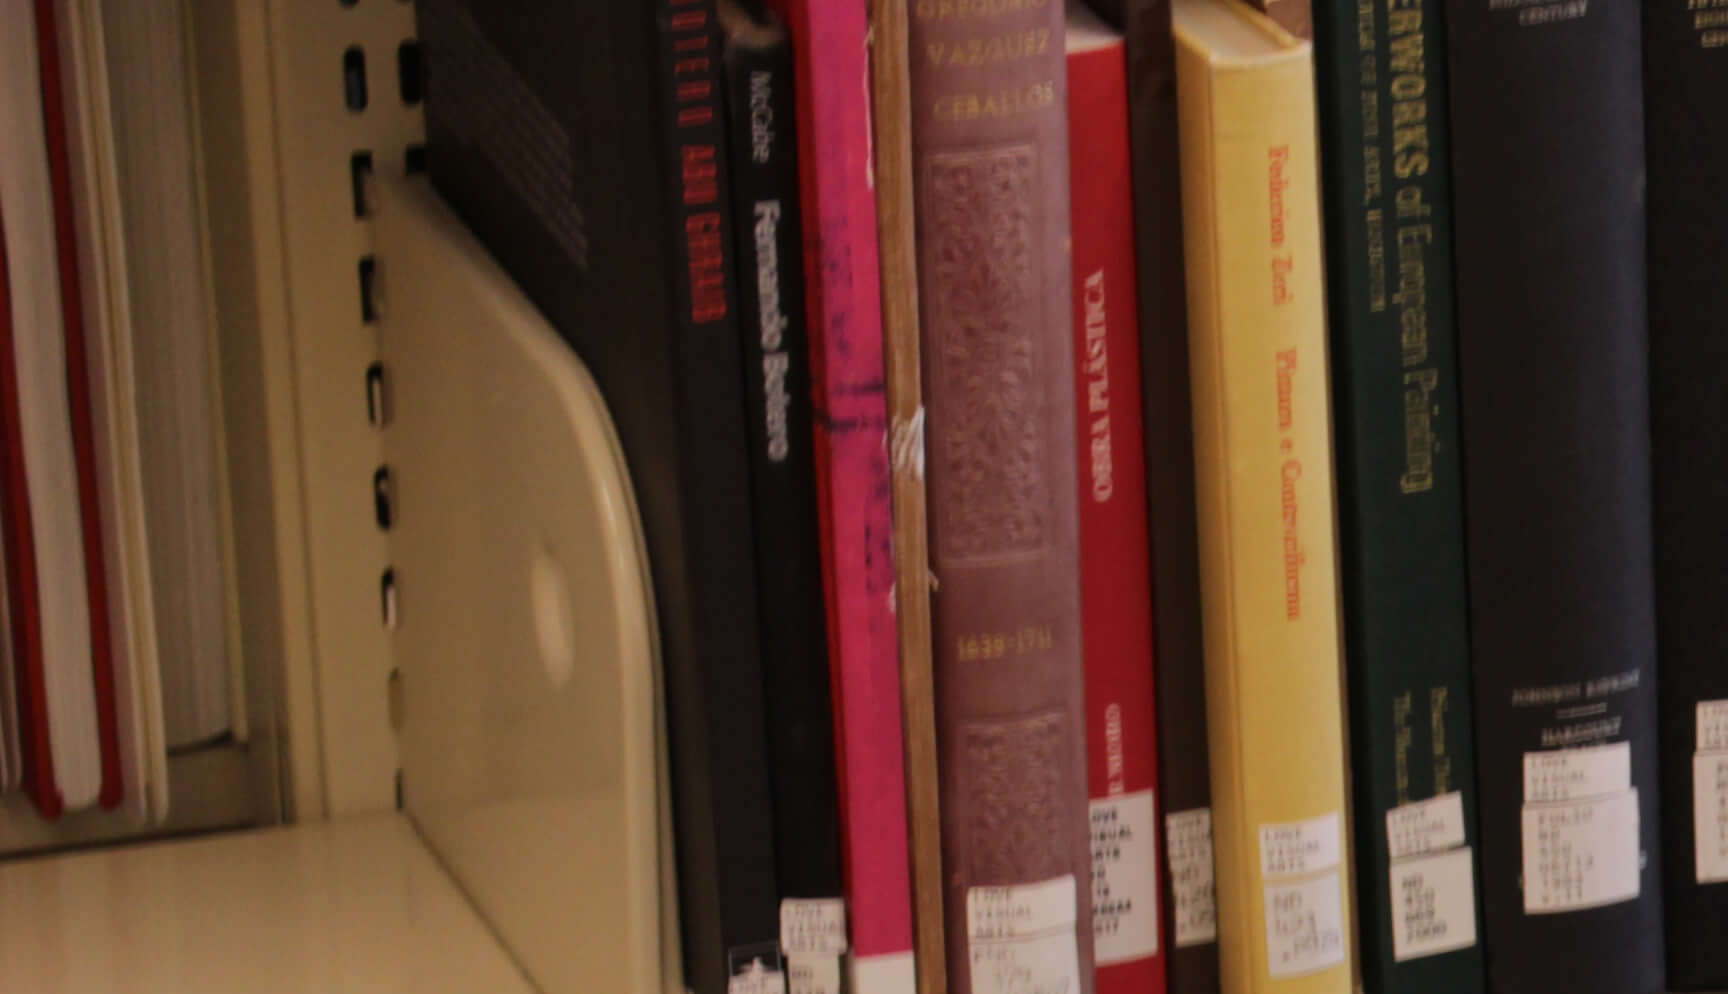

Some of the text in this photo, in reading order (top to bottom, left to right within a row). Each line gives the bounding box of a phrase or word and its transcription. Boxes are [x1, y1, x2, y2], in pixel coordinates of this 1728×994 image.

[749, 69, 776, 164] McCabe
[1396, 186, 1432, 218] of
[754, 200, 790, 463] Fernando Botero
[1392, 222, 1433, 367] European
[1400, 368, 1441, 495] Painting
